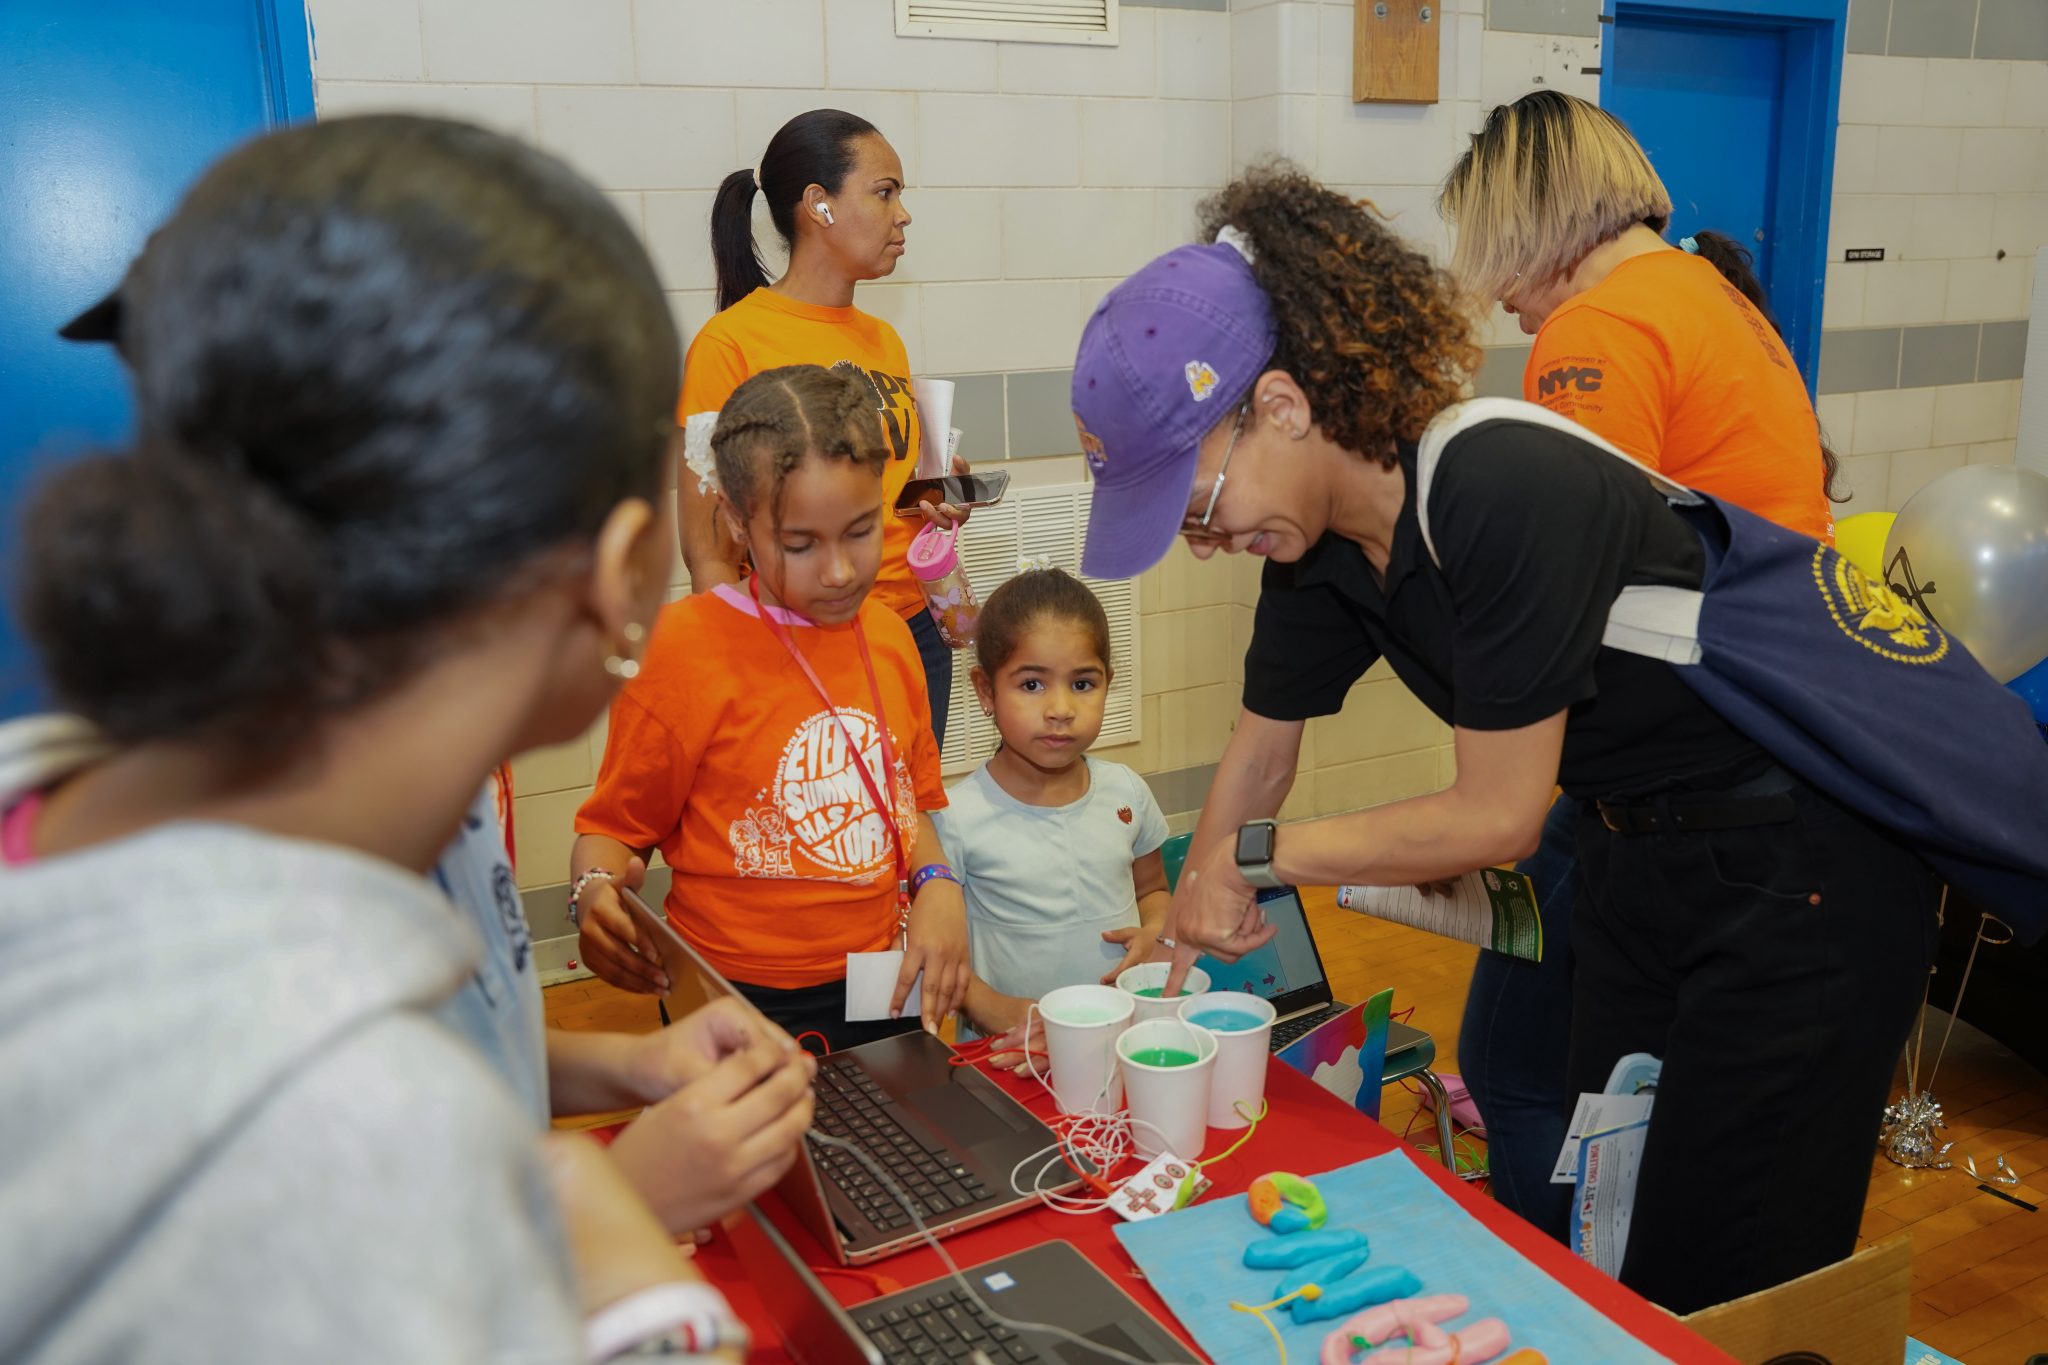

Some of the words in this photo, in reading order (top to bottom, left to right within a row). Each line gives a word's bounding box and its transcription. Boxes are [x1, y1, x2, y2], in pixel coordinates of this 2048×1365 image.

[1538, 366, 1603, 400] NYC
[782, 735, 798, 756] Arts
[800, 709, 830, 729] Science
[784, 715, 881, 781] EVERY
[794, 806, 846, 845] HAS
[1588, 1143, 1600, 1184] CHALLENGE
